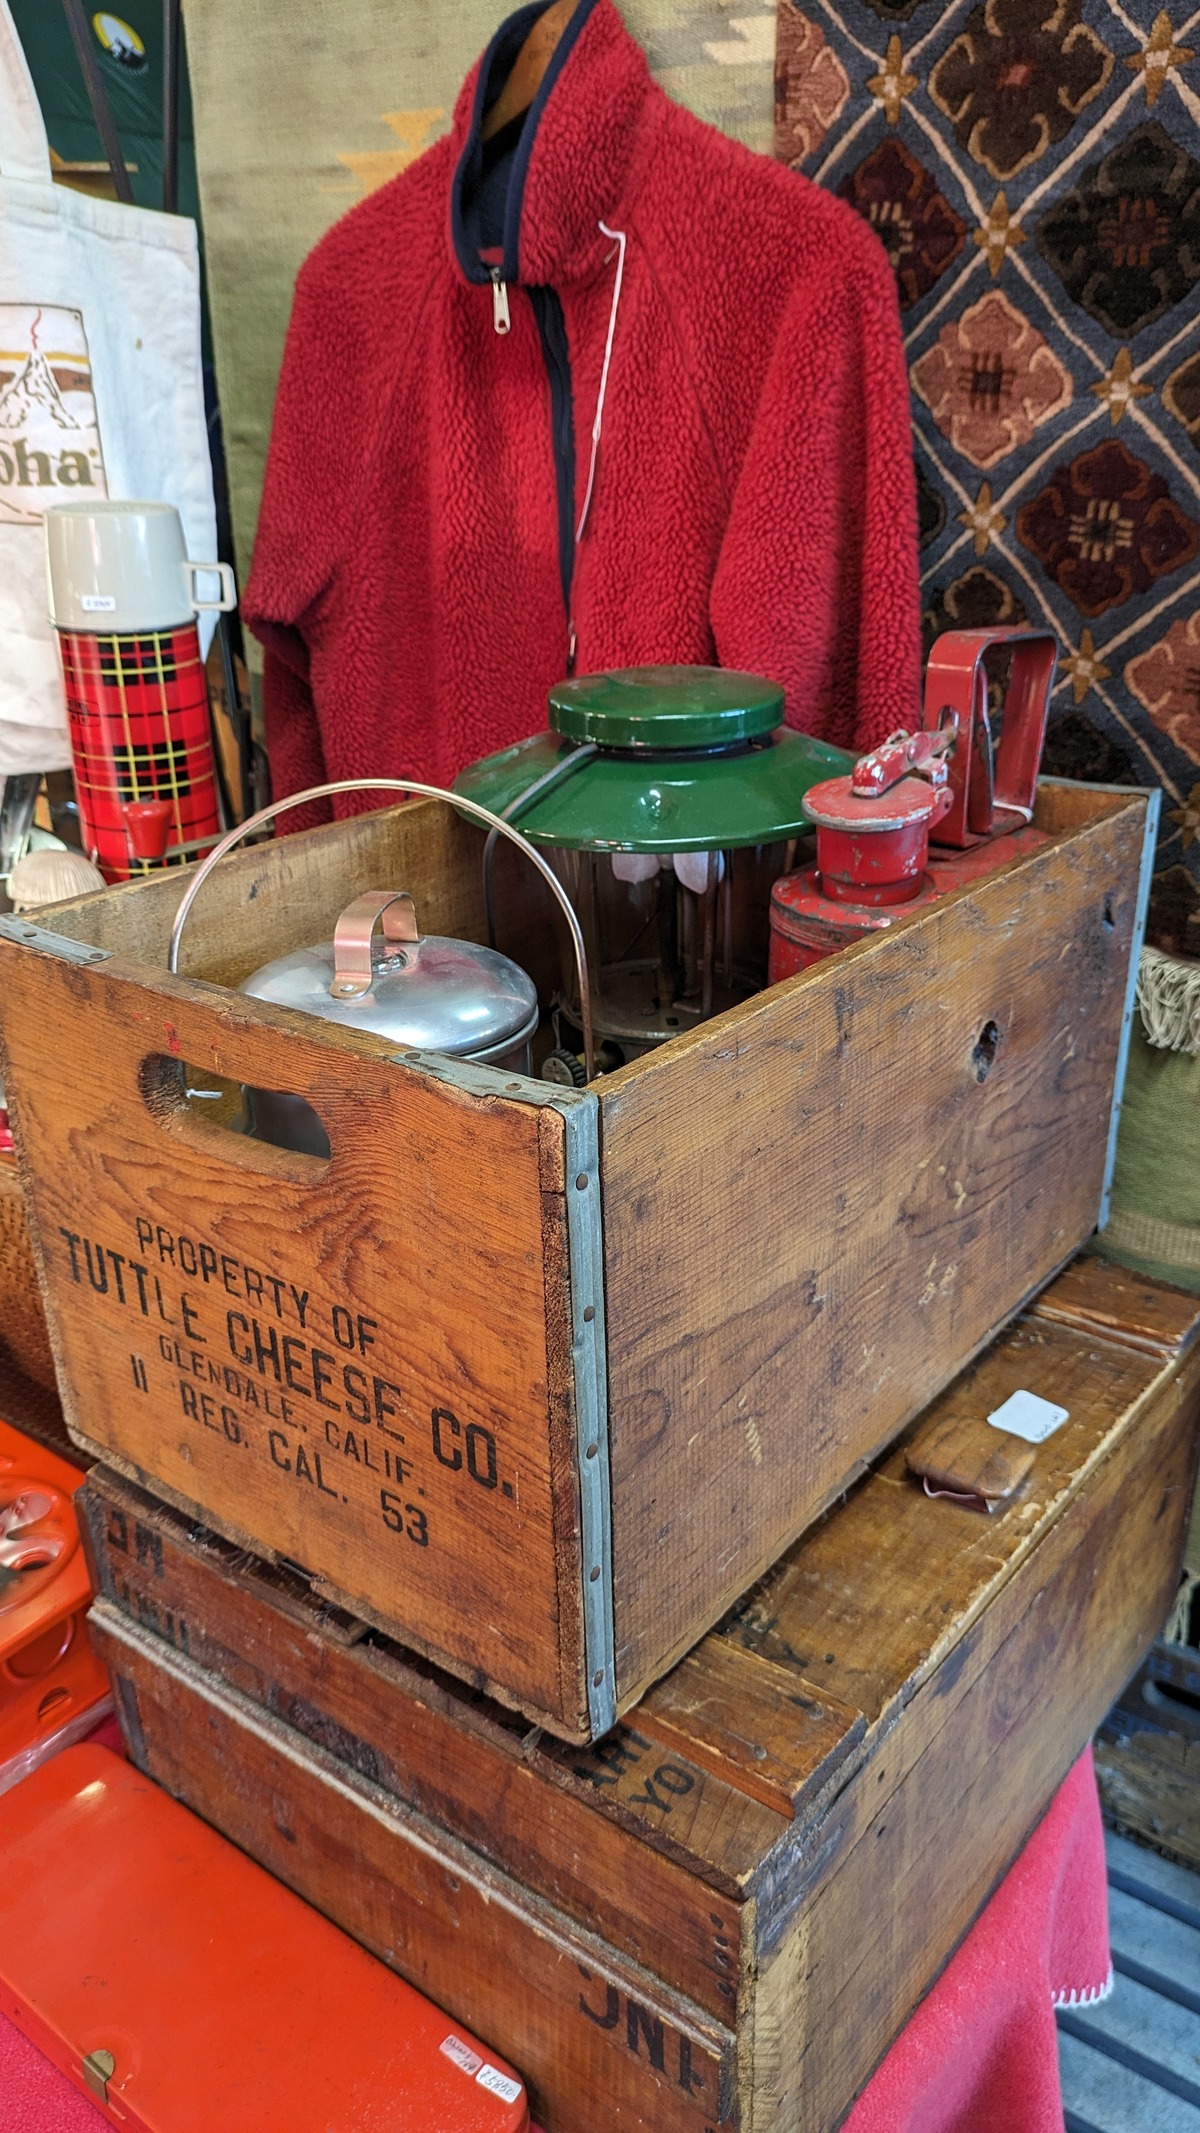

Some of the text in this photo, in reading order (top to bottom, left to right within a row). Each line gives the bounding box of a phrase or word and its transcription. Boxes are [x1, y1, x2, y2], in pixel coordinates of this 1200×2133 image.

[136, 1217, 377, 1356] PROPERTY OF
[59, 1228, 513, 1499] TUTTLE CHEESE CO.
[181, 1381, 249, 1449] REG.
[269, 1429, 348, 1504] CAL.
[380, 1489, 429, 1546] 53
[325, 1420, 425, 1496] CALIF.
